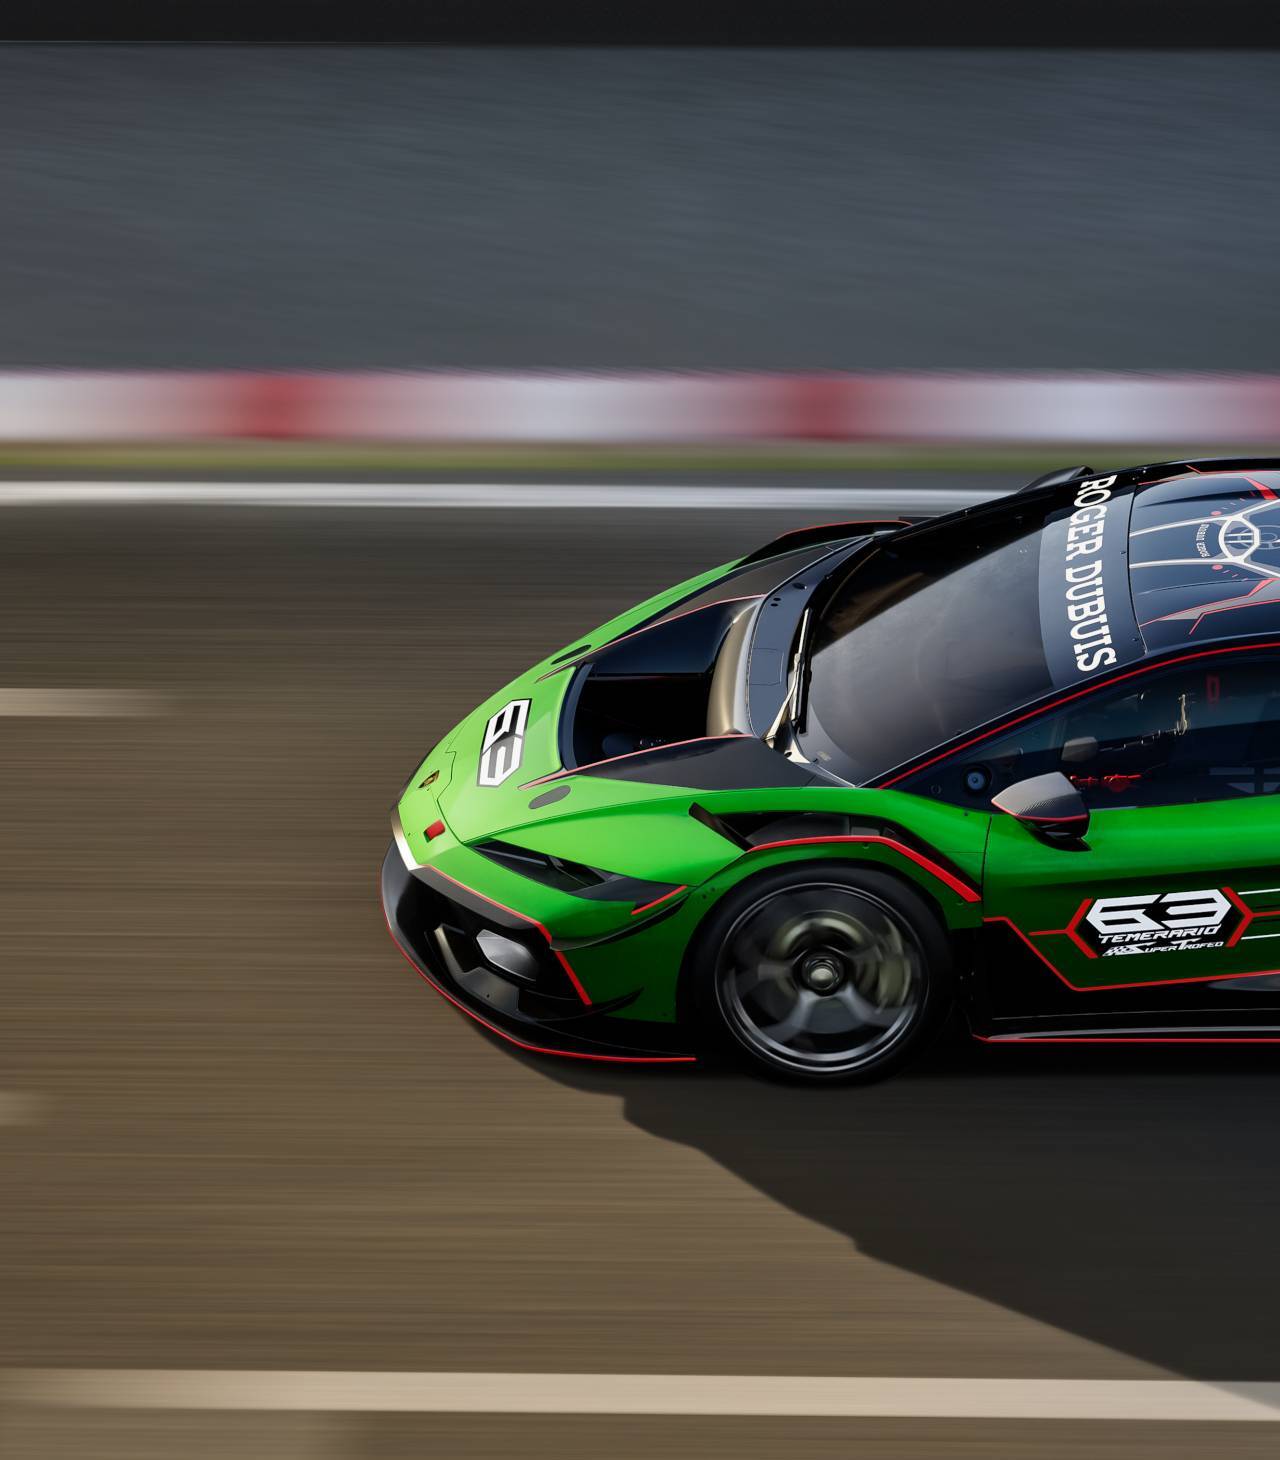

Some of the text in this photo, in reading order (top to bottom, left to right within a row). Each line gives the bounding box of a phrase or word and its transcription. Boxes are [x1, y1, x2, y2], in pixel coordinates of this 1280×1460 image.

[1065, 474, 1118, 672] ROGER DUBUIS
[478, 699, 531, 787] 63
[1085, 888, 1232, 935] 63
[1098, 923, 1222, 944] TEMERARIO
